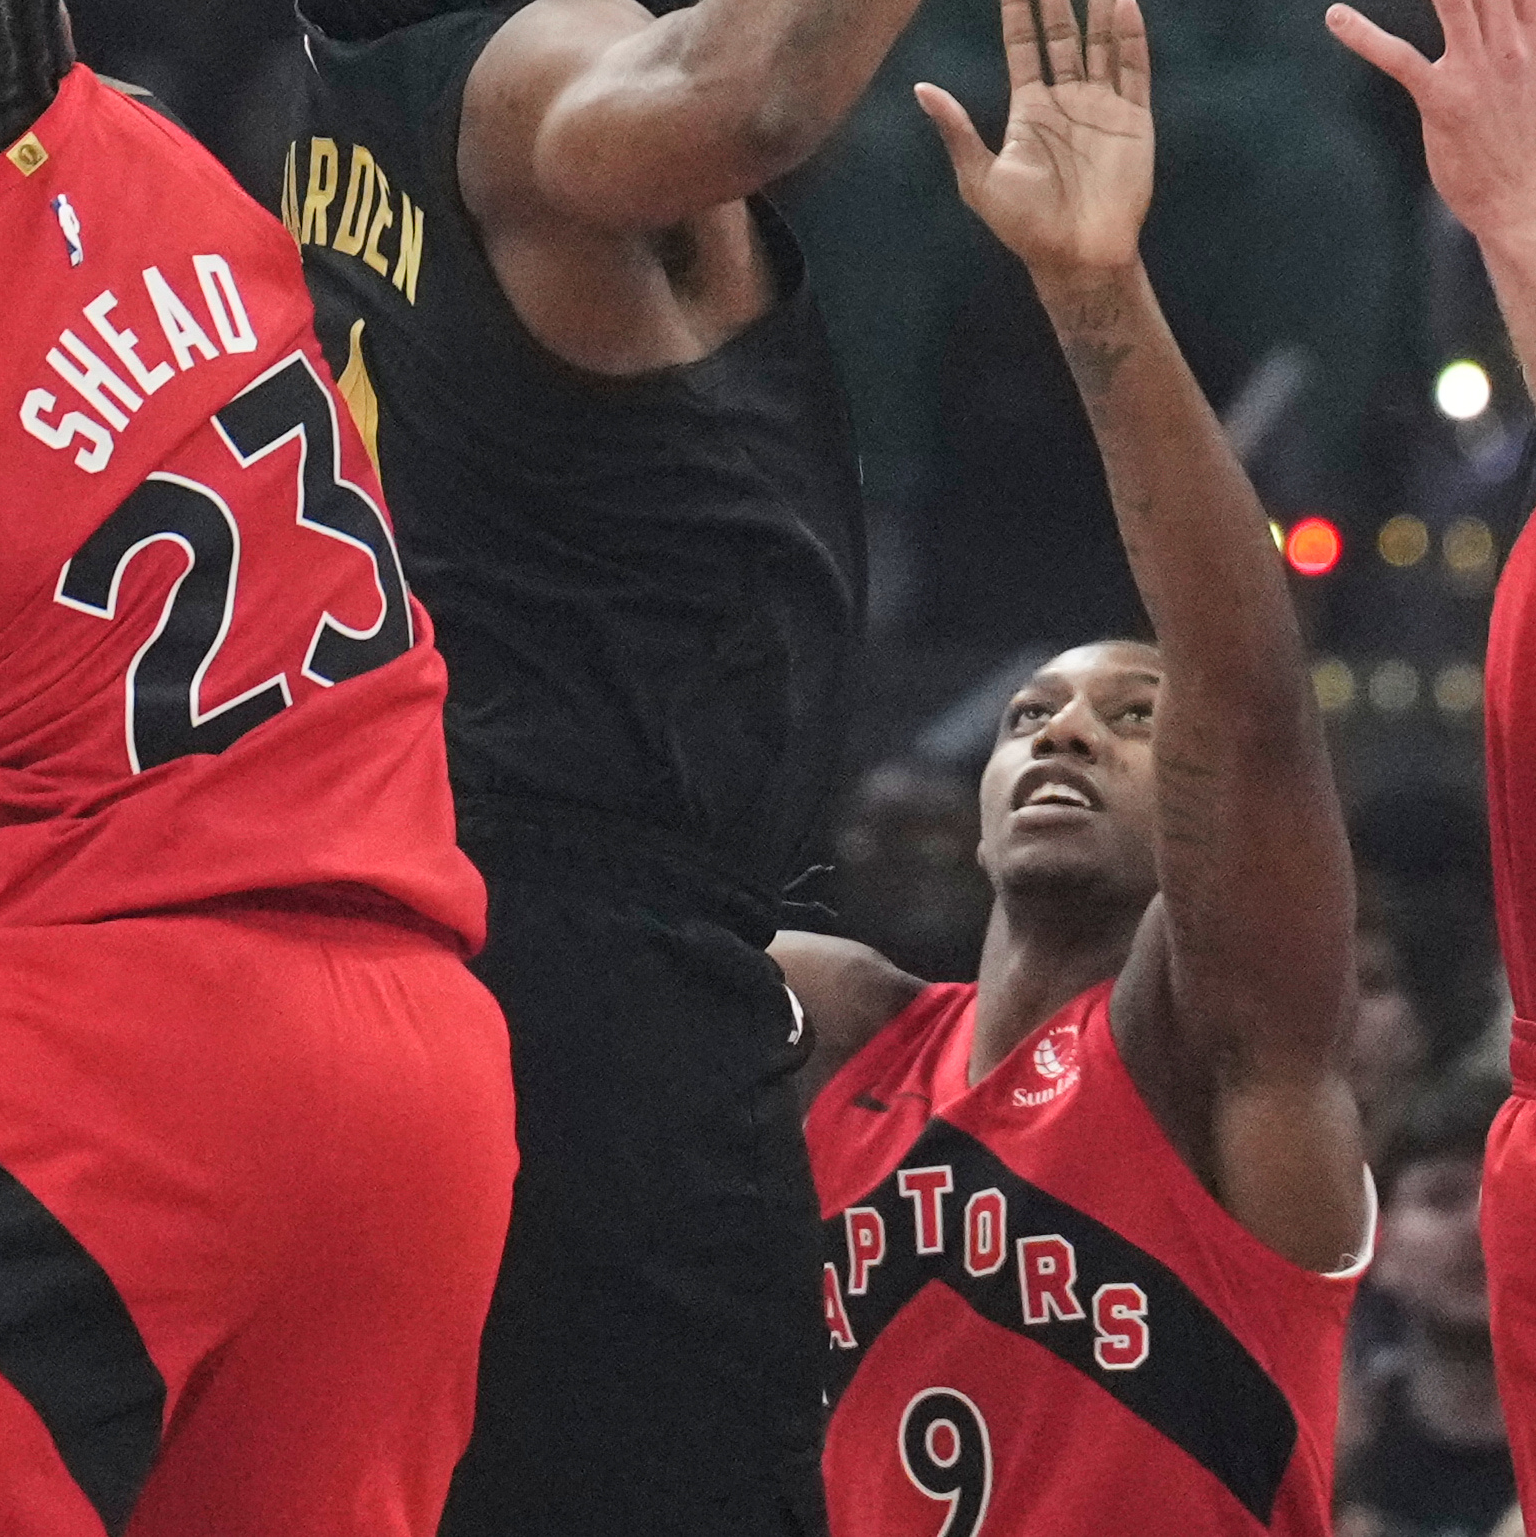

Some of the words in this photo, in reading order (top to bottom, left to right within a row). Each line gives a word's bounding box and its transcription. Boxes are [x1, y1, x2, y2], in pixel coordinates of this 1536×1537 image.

[280, 136, 425, 306] ARDEN
[19, 253, 258, 475] SHEAD
[53, 349, 415, 775] 23
[822, 1165, 1150, 1371] APTORS
[897, 1386, 995, 1537] 9
